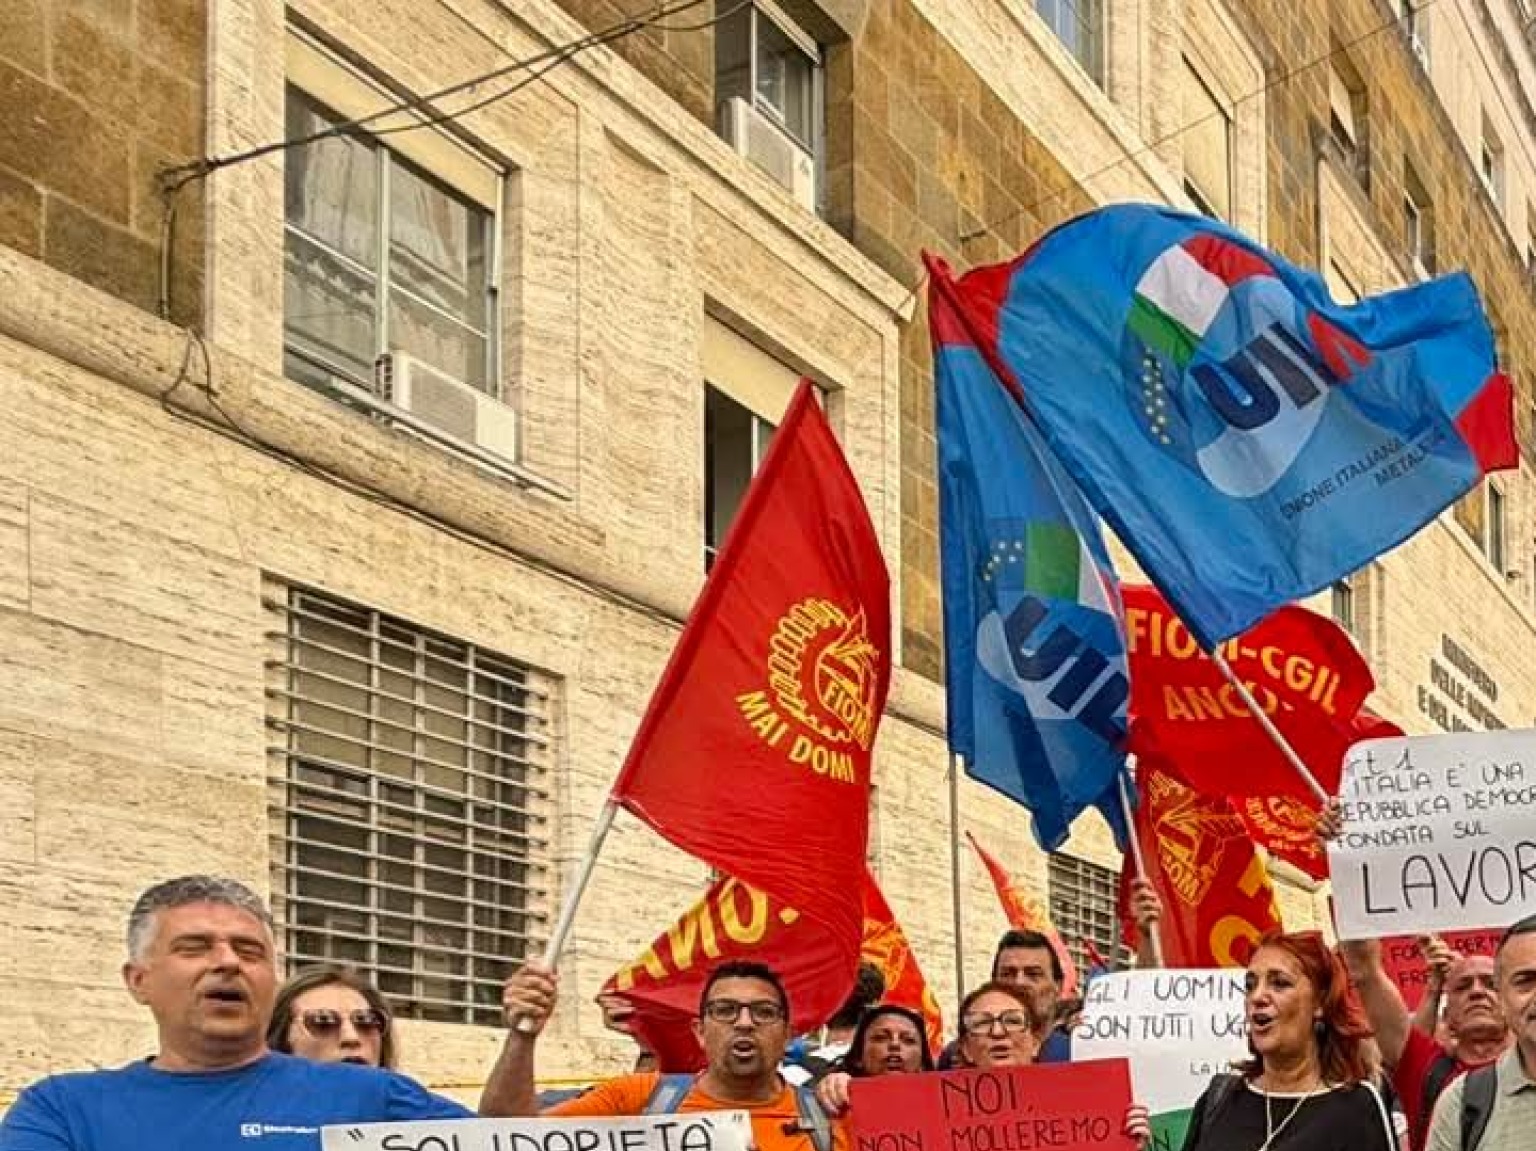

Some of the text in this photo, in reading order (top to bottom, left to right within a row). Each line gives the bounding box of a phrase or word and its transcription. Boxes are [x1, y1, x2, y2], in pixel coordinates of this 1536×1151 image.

[1125, 608, 1341, 715] FIO-CGIL
[736, 690, 789, 746] MAI
[1482, 762, 1523, 785] UNA
[1454, 820, 1490, 839] SUL
[1079, 1014, 1132, 1040] SON
[1138, 1012, 1194, 1041] TUTTI
[940, 1072, 1034, 1119] NOI,
